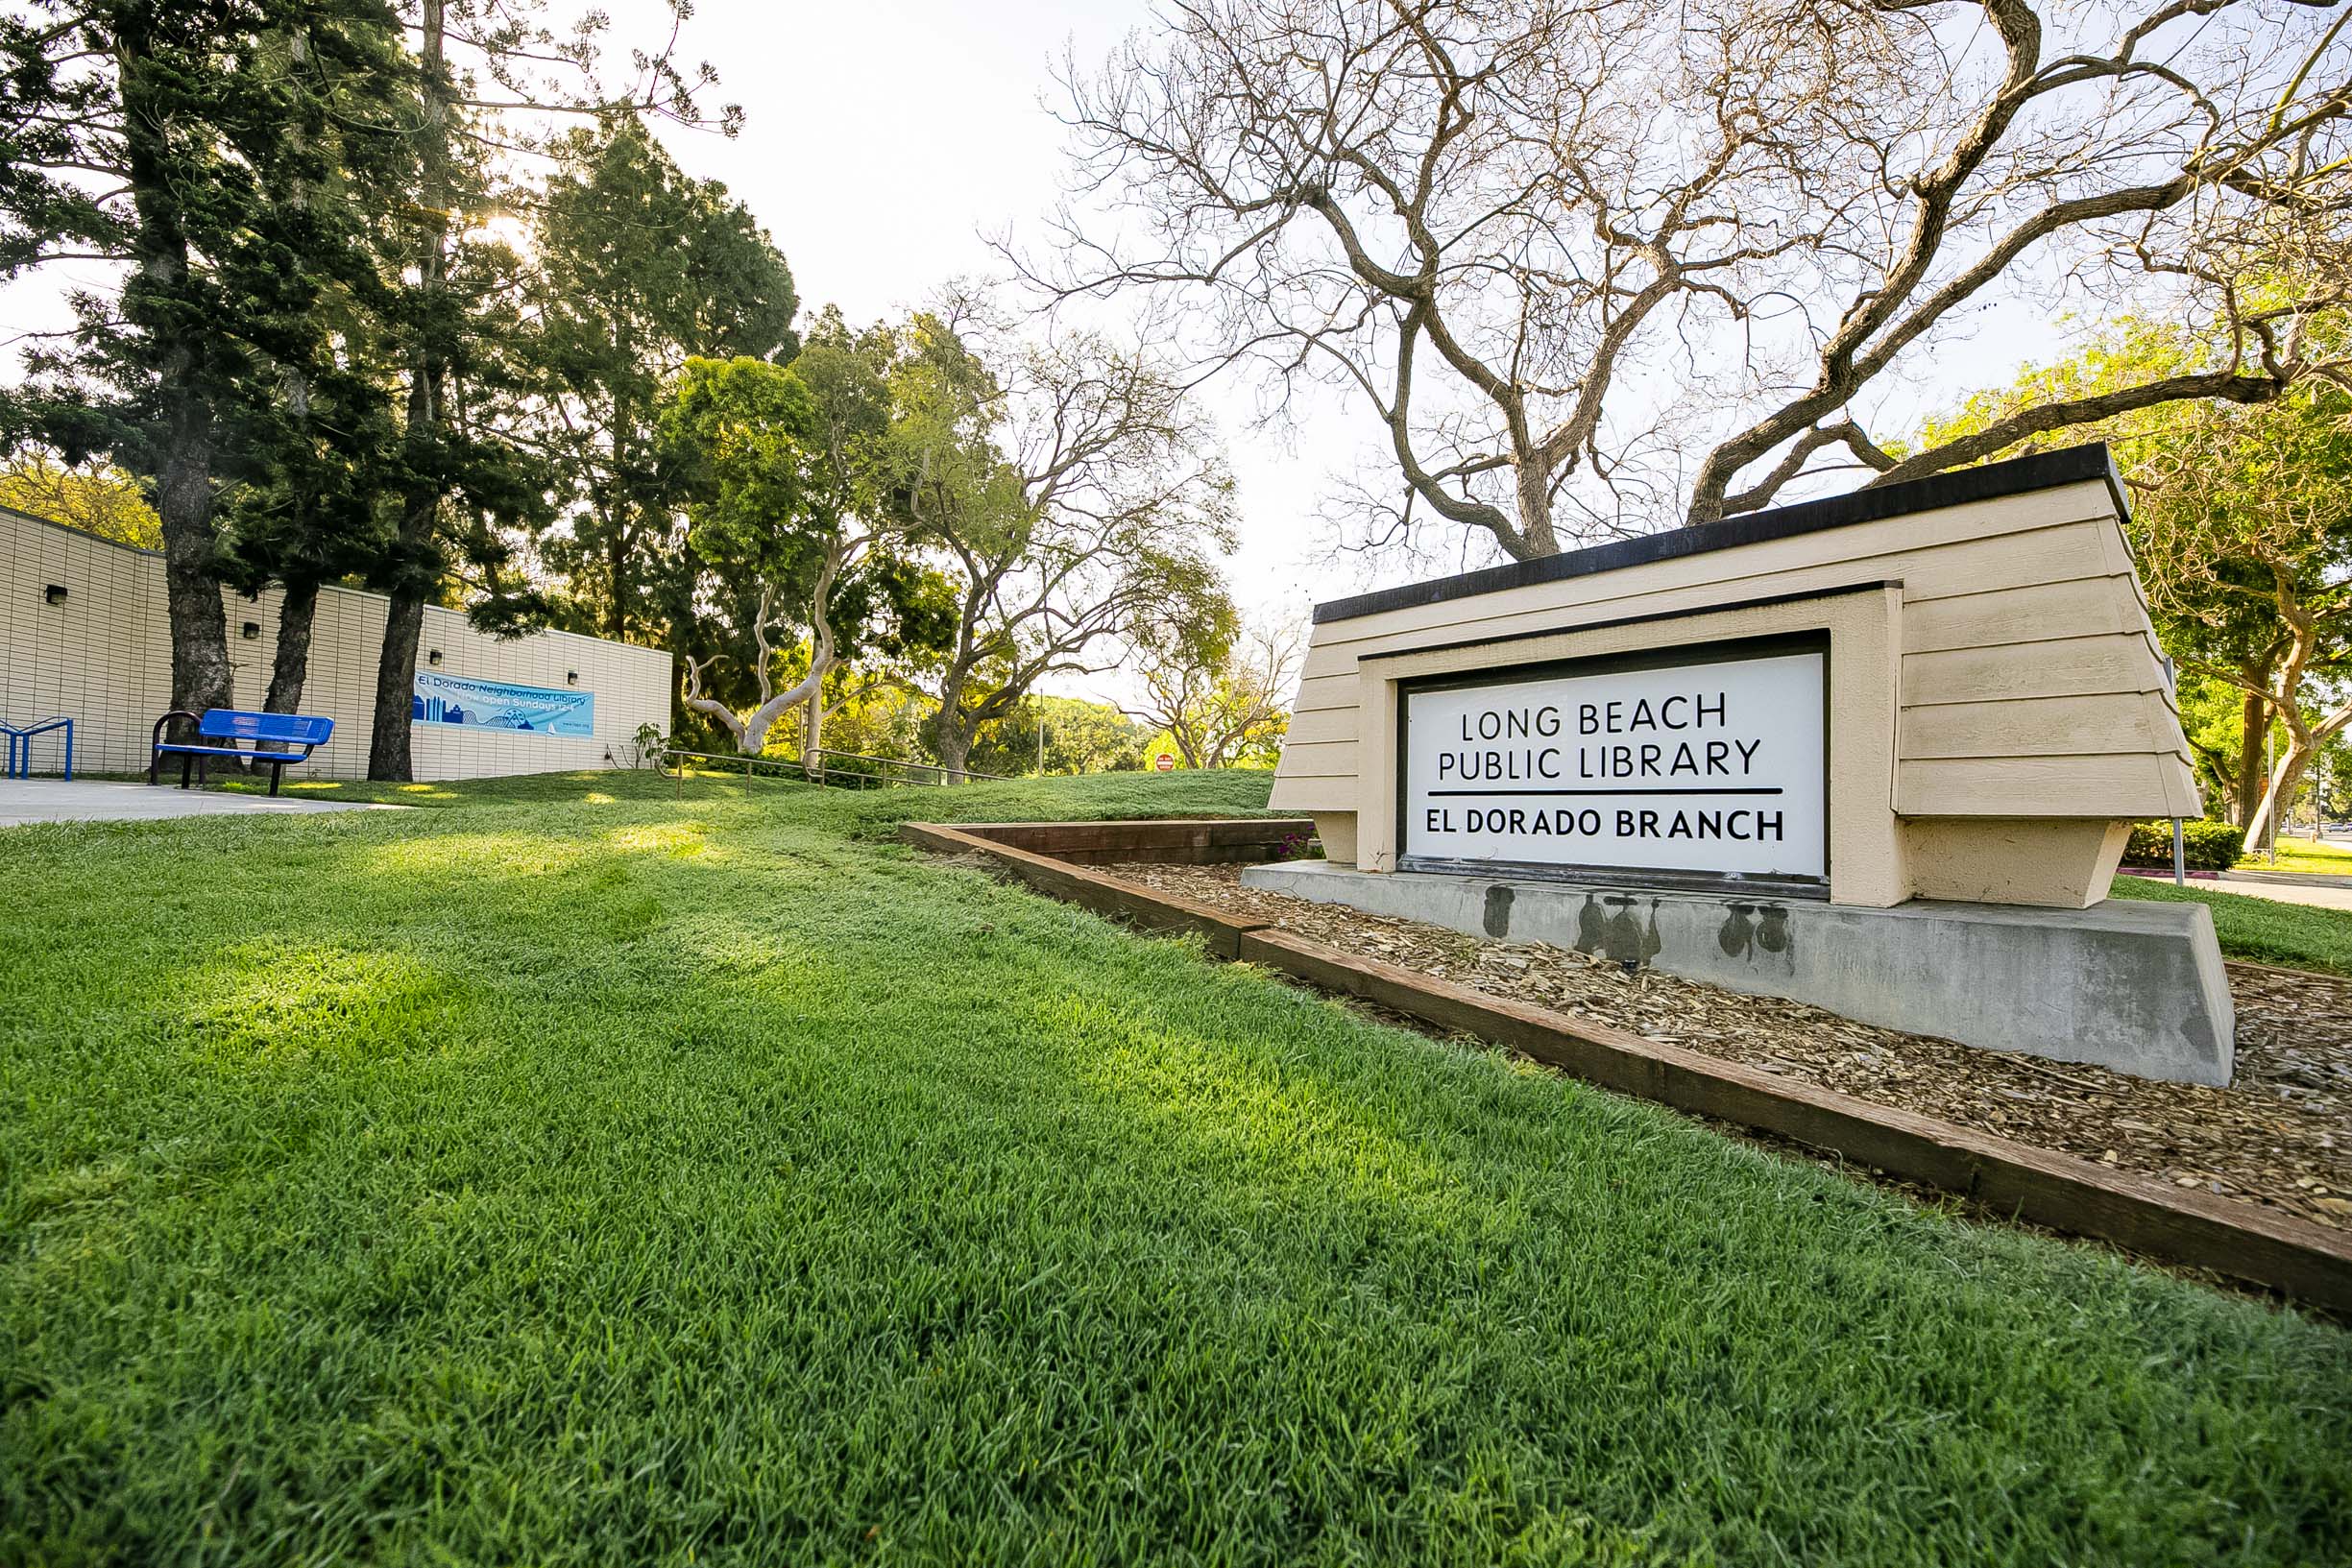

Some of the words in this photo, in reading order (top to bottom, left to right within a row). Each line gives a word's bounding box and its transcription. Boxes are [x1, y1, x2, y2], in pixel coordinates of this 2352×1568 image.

[419, 676, 430, 685] El
[433, 678, 476, 691] Dorado
[479, 686, 551, 701] Neighborhood
[554, 694, 586, 706] Library
[483, 696, 510, 706] open
[513, 699, 555, 712] Sundays
[1462, 706, 1561, 741] LONG
[1580, 691, 1726, 736] BEACH
[1439, 748, 1561, 781] PUBLIC
[1580, 738, 1761, 779] LIBRARY
[1426, 808, 1457, 832] EL
[1466, 808, 1601, 837] DORADO
[1615, 809, 1783, 841] BRANCH
